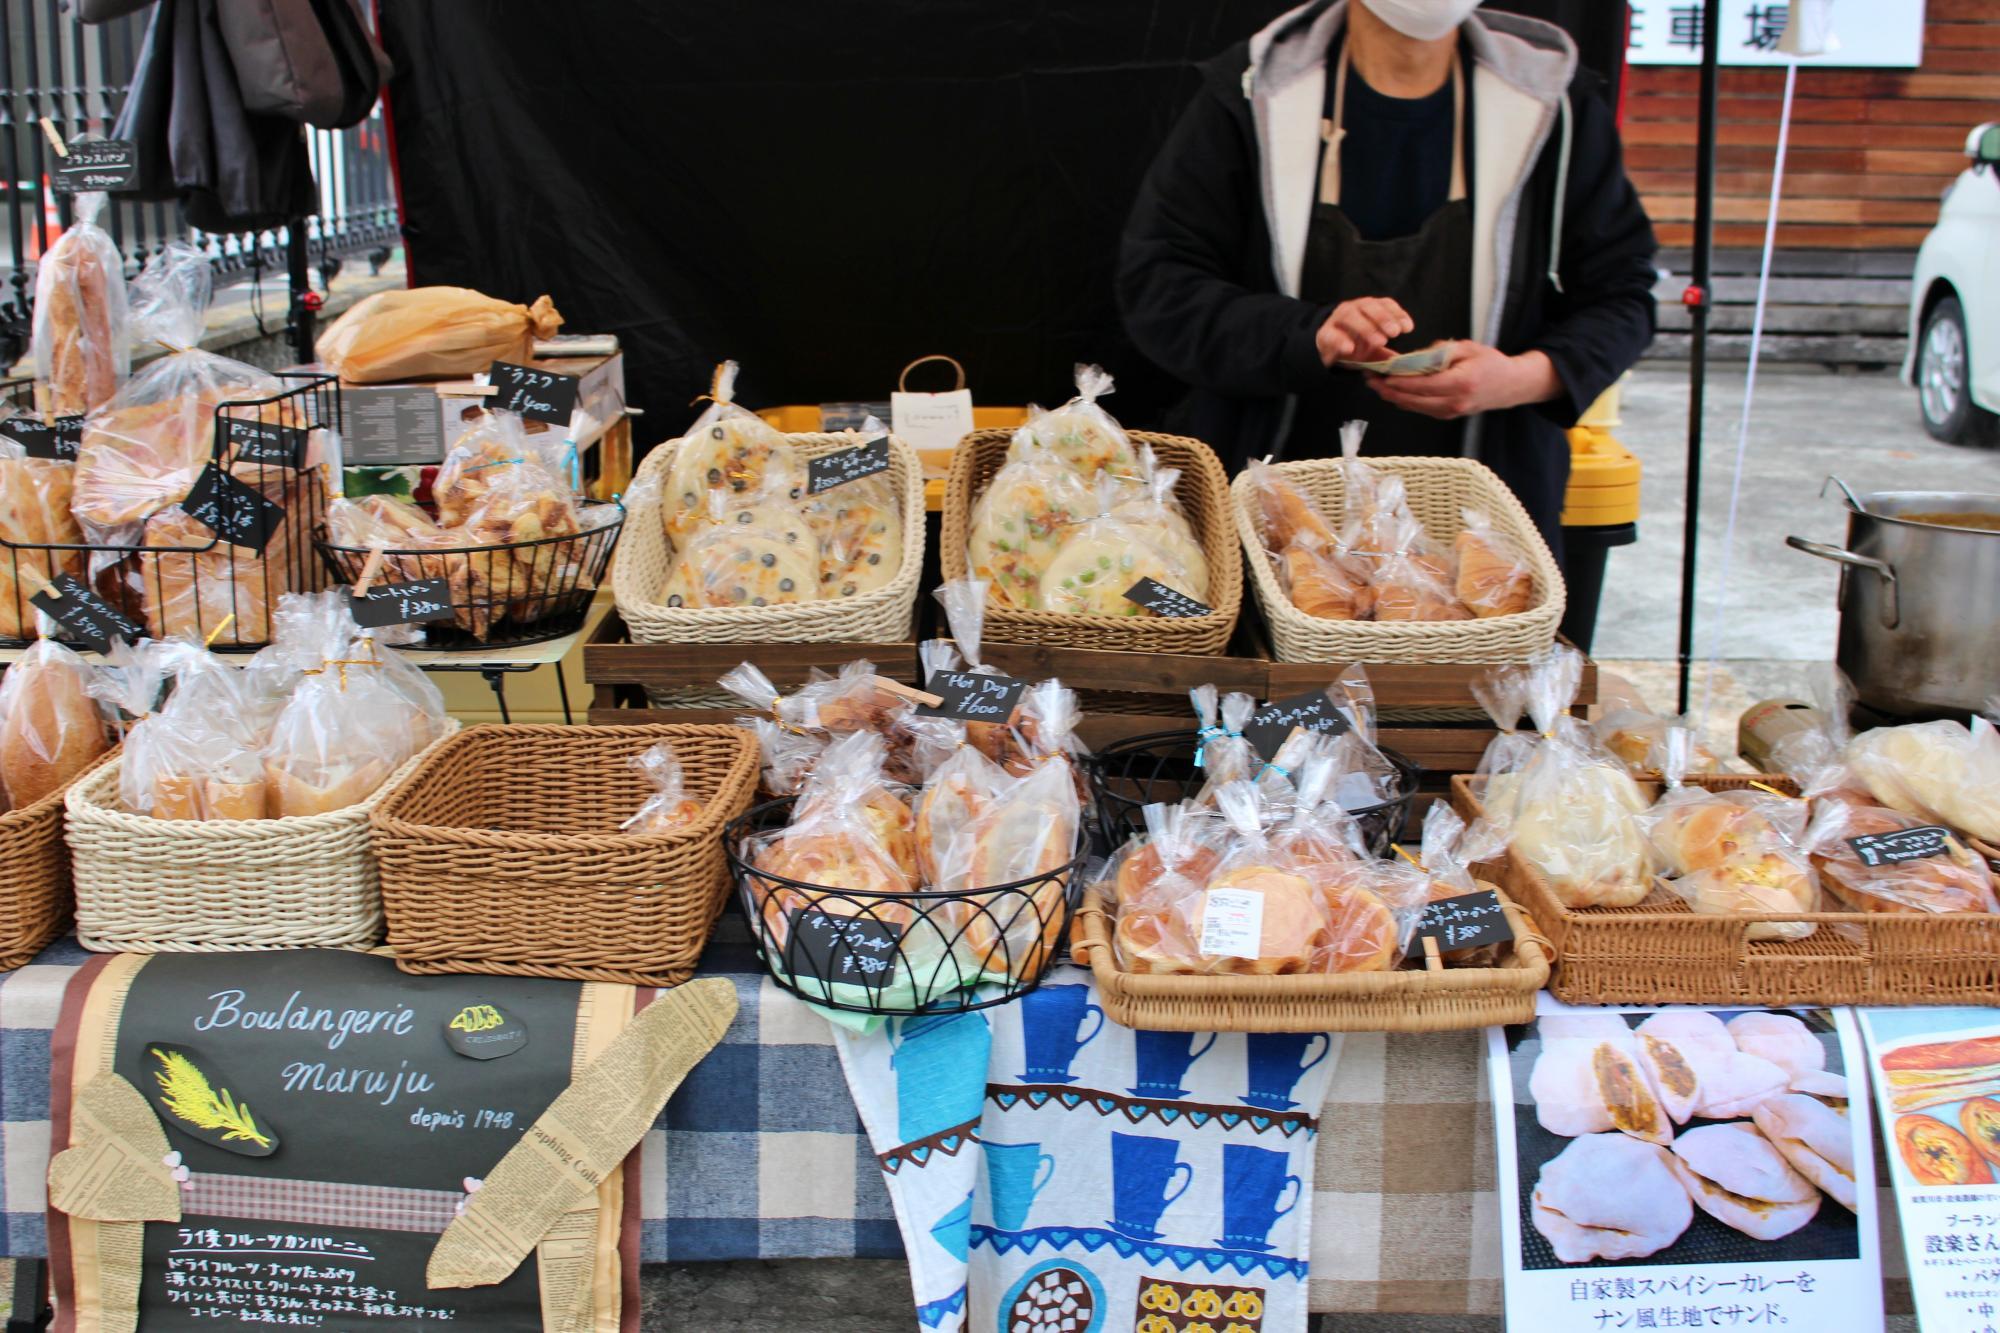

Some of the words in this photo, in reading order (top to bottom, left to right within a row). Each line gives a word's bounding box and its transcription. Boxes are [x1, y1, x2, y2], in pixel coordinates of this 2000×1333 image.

[947, 674, 975, 689] Hot
[982, 679, 1009, 699] Dog
[194, 989, 414, 1050] Boulangerie
[281, 1060, 435, 1105] Maruju
[410, 1108, 465, 1131] depuis
[177, 1228, 369, 1252] ライ麦フルーツカンパーニュ
[1924, 1233, 2000, 1254] 設楽さん
[1570, 1271, 1817, 1302] 自家製スパイシーカレーを
[1593, 1303, 1789, 1331] ナン風生地でサンド。
